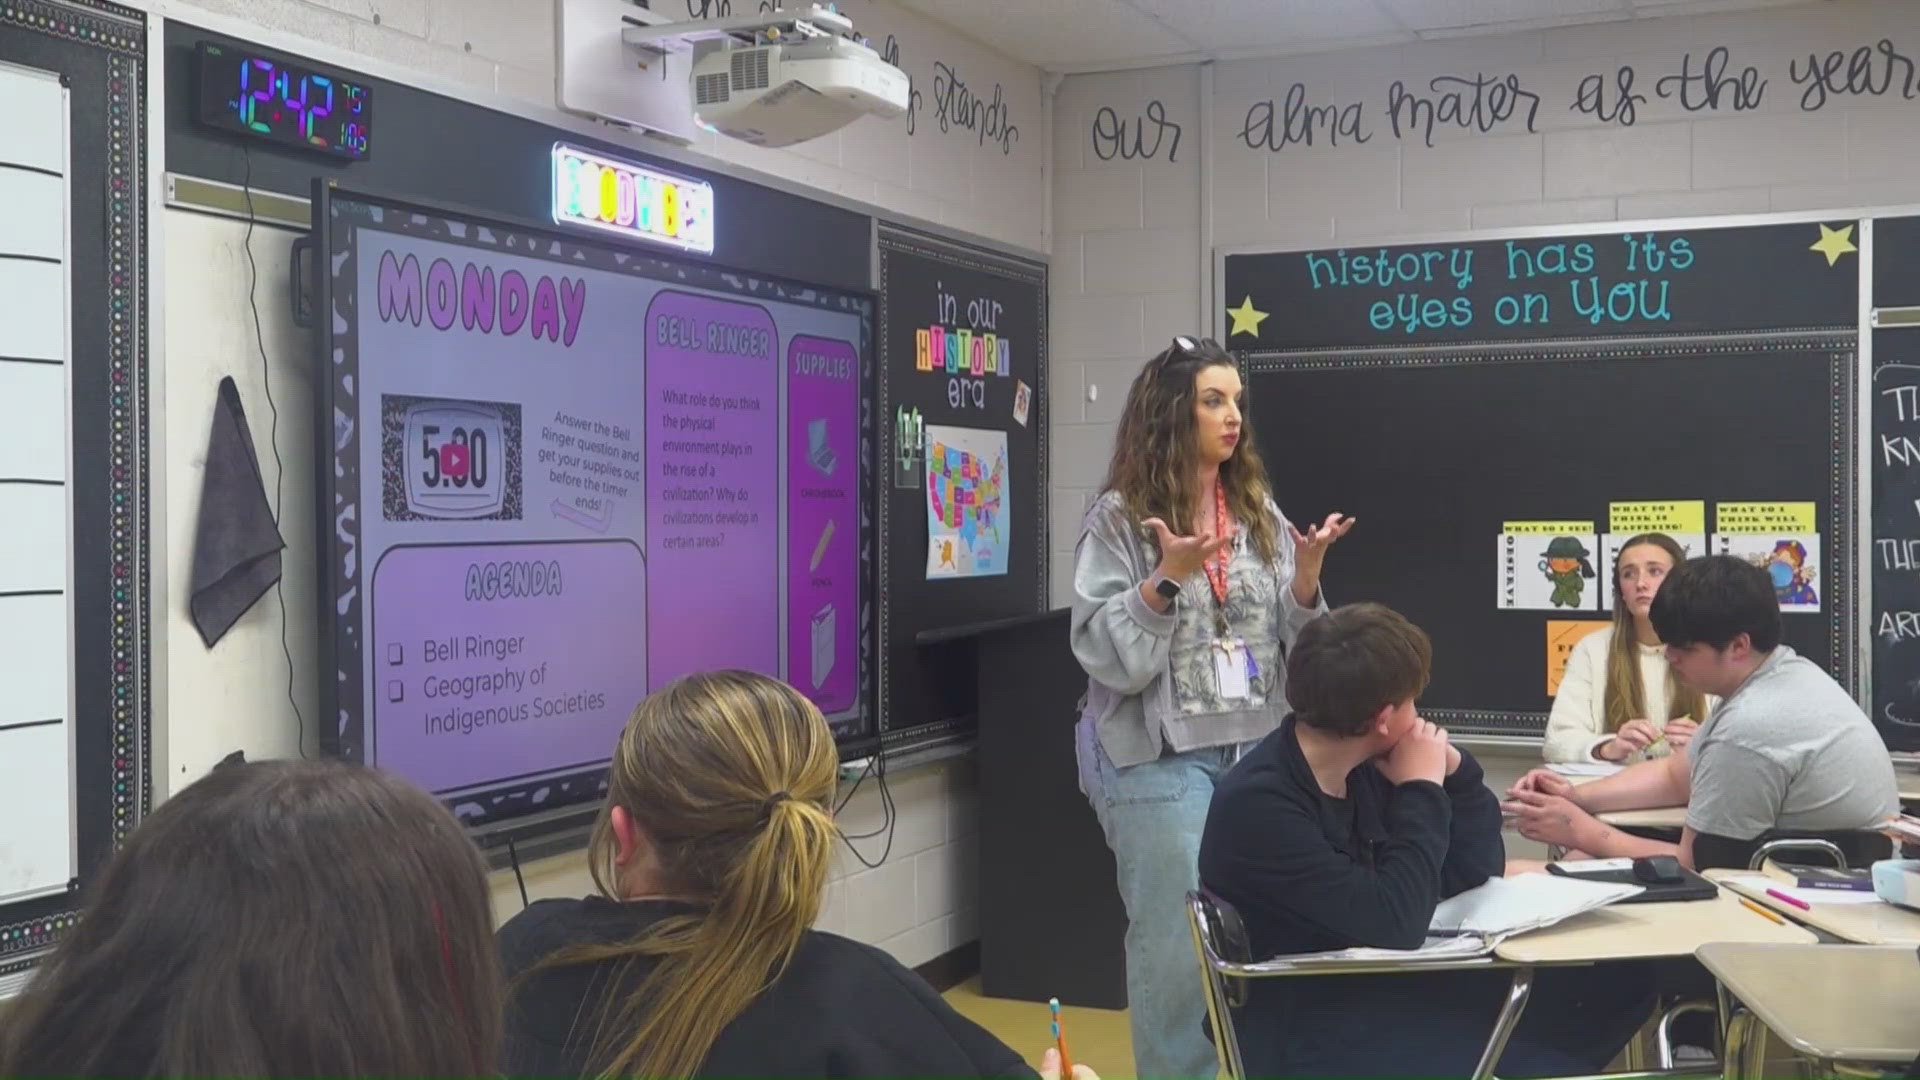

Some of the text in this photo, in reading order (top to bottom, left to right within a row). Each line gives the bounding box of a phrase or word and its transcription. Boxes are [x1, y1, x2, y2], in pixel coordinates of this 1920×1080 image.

[239, 58, 332, 147] 12:42
[1237, 82, 1373, 151] alma
[1386, 72, 1540, 148] mater
[1570, 66, 1647, 126] as
[1656, 46, 1768, 111] the
[1790, 39, 1920, 112] year
[1305, 232, 1695, 289] history has its
[377, 249, 586, 348] MONDAY
[936, 280, 1003, 330] in our
[1369, 293, 1473, 334] eyes
[1494, 292, 1550, 325] on
[657, 314, 770, 359] BELL RINGER
[917, 327, 1008, 374] HISTORY
[794, 352, 852, 380] SUPPLIES
[662, 389, 761, 411] What role do you think
[947, 377, 986, 409] era
[554, 411, 631, 441] Answer the Bell
[662, 413, 716, 432] the physical
[542, 427, 640, 463] Ringer question and
[662, 440, 753, 458] environment plays in
[538, 449, 640, 482] get your supplies out
[662, 461, 716, 477] the rise of a
[549, 469, 629, 498] before the timer
[662, 485, 749, 503] civilization? Why do
[662, 510, 714, 525] civilizations
[715, 509, 750, 527] develop
[662, 532, 725, 549] certain areas?
[465, 560, 563, 601] AGENDA
[1506, 535, 1515, 607] OBSERVE
[424, 634, 525, 663] Bell Ringer
[424, 662, 548, 699] Geography of
[425, 689, 606, 736] Indigenous Societies
